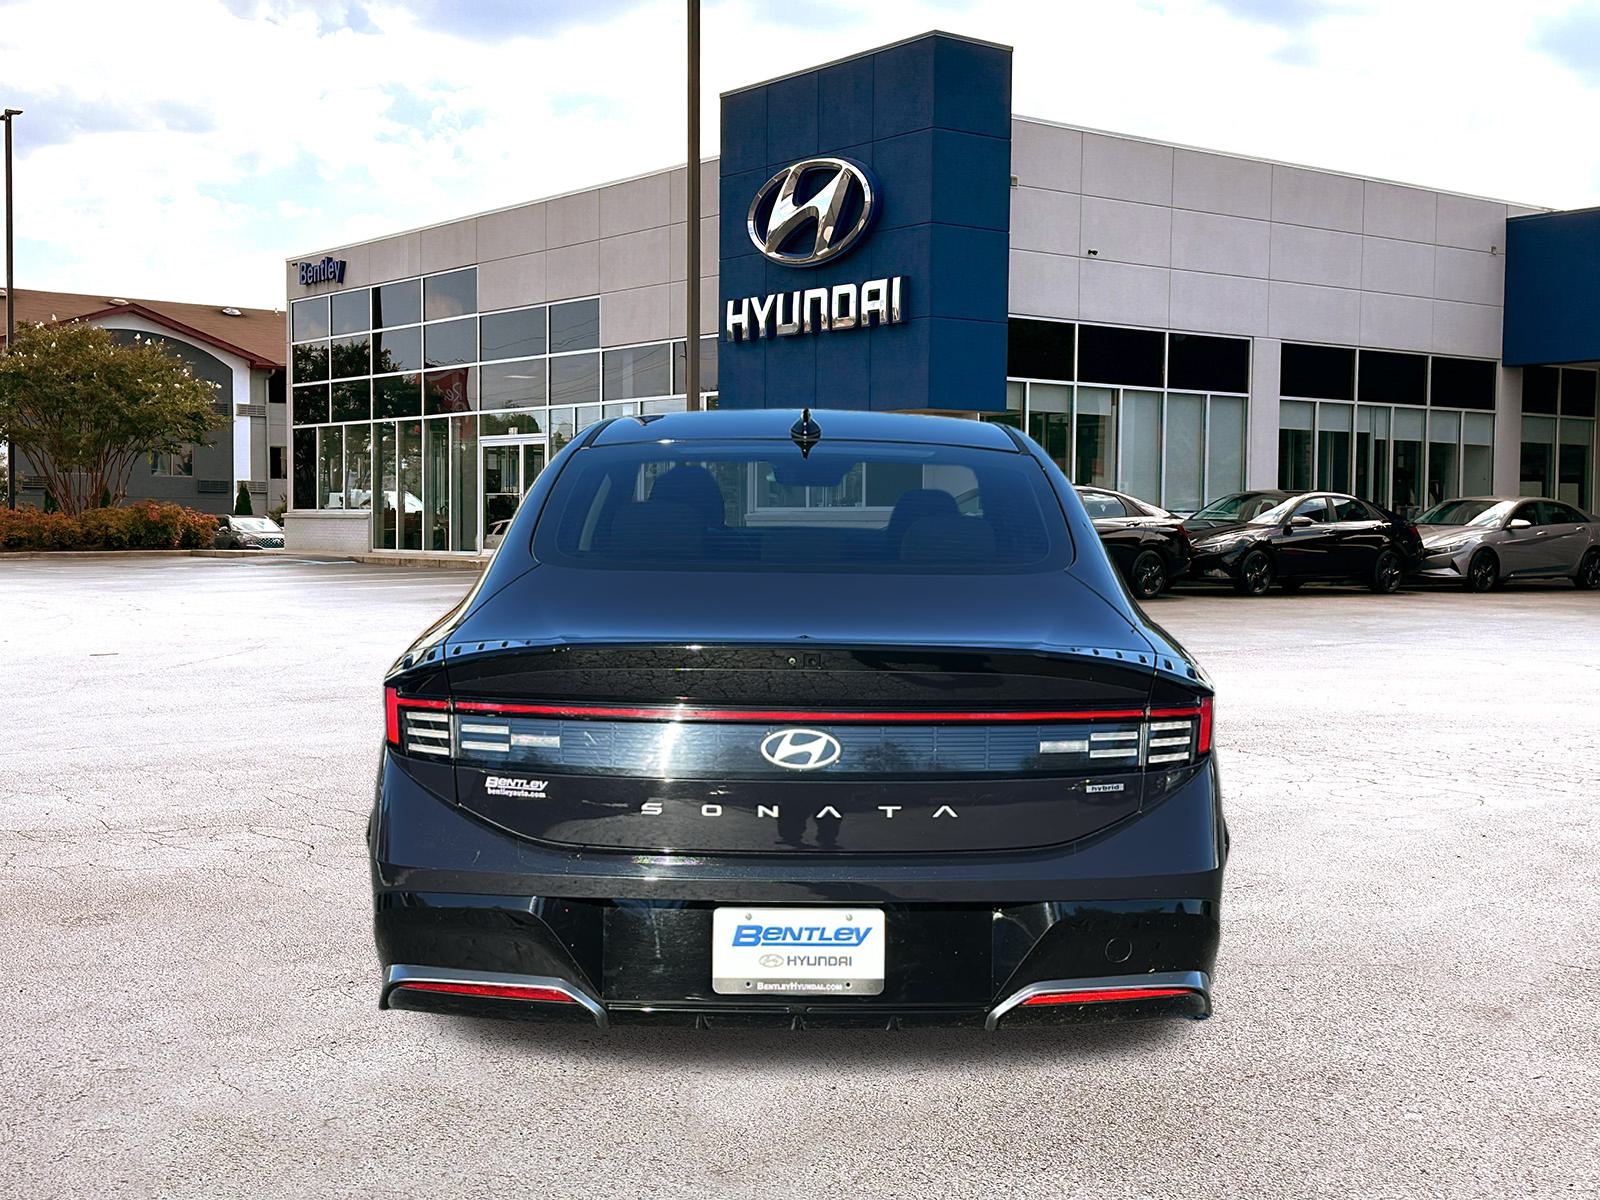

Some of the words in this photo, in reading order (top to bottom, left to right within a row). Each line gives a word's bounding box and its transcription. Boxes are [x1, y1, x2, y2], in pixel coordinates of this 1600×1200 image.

[300, 257, 343, 285] Bentley
[726, 276, 902, 341] HYUNDAI
[487, 787, 547, 798] bentleyauto.com
[1090, 784, 1121, 792] hybrid
[641, 802, 958, 818] SONATA
[787, 956, 852, 966] HYUNDAI
